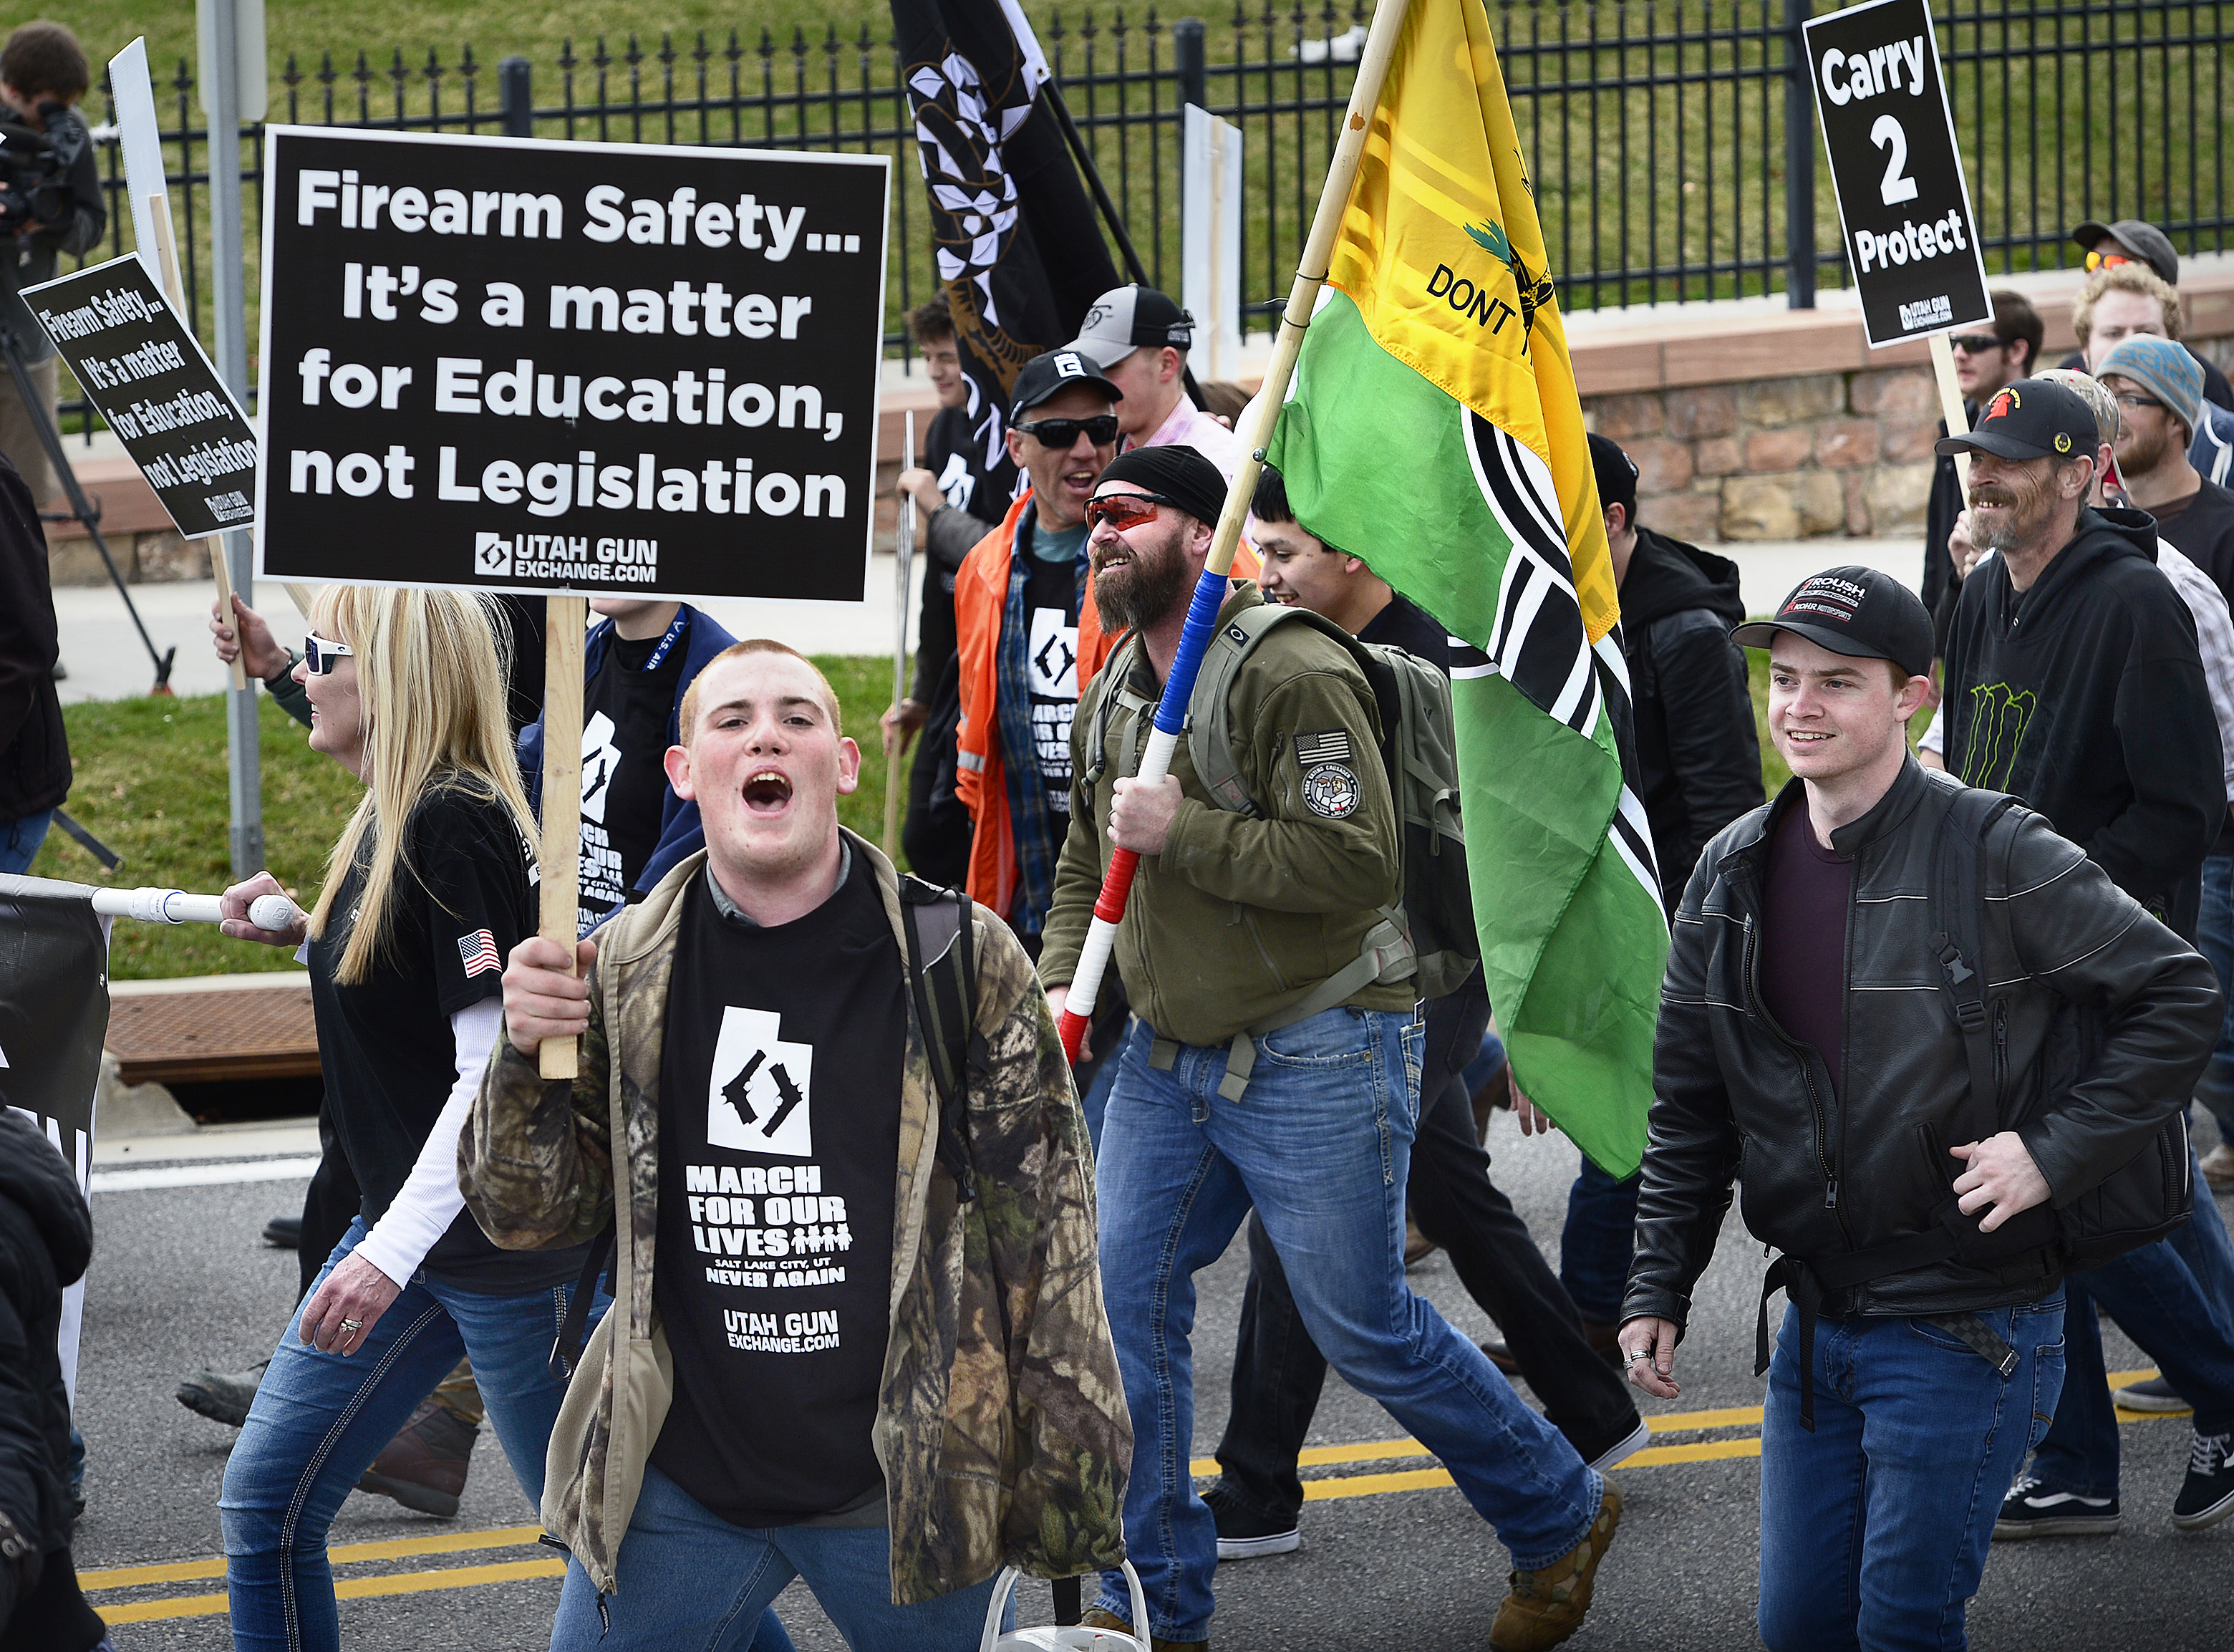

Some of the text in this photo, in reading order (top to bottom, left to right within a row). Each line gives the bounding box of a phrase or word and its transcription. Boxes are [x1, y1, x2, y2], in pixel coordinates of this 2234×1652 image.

[1822, 36, 1923, 105] Carry
[1870, 115, 1918, 205] 2
[299, 170, 859, 261] Firearm Safety...
[1855, 209, 1966, 273] Protect
[39, 287, 164, 343] Firearm Safety...
[481, 283, 523, 326] a
[550, 281, 811, 339] matter
[1426, 263, 1517, 335] DONT
[1909, 294, 1951, 317] UTAH GUN
[110, 358, 132, 384] a
[122, 340, 186, 380] matter
[2112, 348, 2200, 405] adida
[299, 349, 842, 440] for Education,
[107, 388, 234, 440] for Education,
[143, 455, 180, 489] not
[291, 445, 845, 517] not Legislation
[516, 533, 658, 565] UTAH GUN
[515, 561, 657, 583] EXCHANGE.COM
[1812, 577, 1865, 598] ROUSH
[647, 633, 675, 670] U.S. AIR
[1033, 703, 1077, 723] ARC
[686, 1166, 821, 1194] MARCH
[688, 1196, 846, 1226] FOR OUR
[692, 1225, 790, 1256] LIVES
[706, 1267, 846, 1288] NEVER AGAIN
[715, 1257, 831, 1270] SALT LAKE CITY, UT
[724, 1309, 838, 1336] UTAH GUN
[727, 1333, 840, 1353] EXCHANGE.COM
